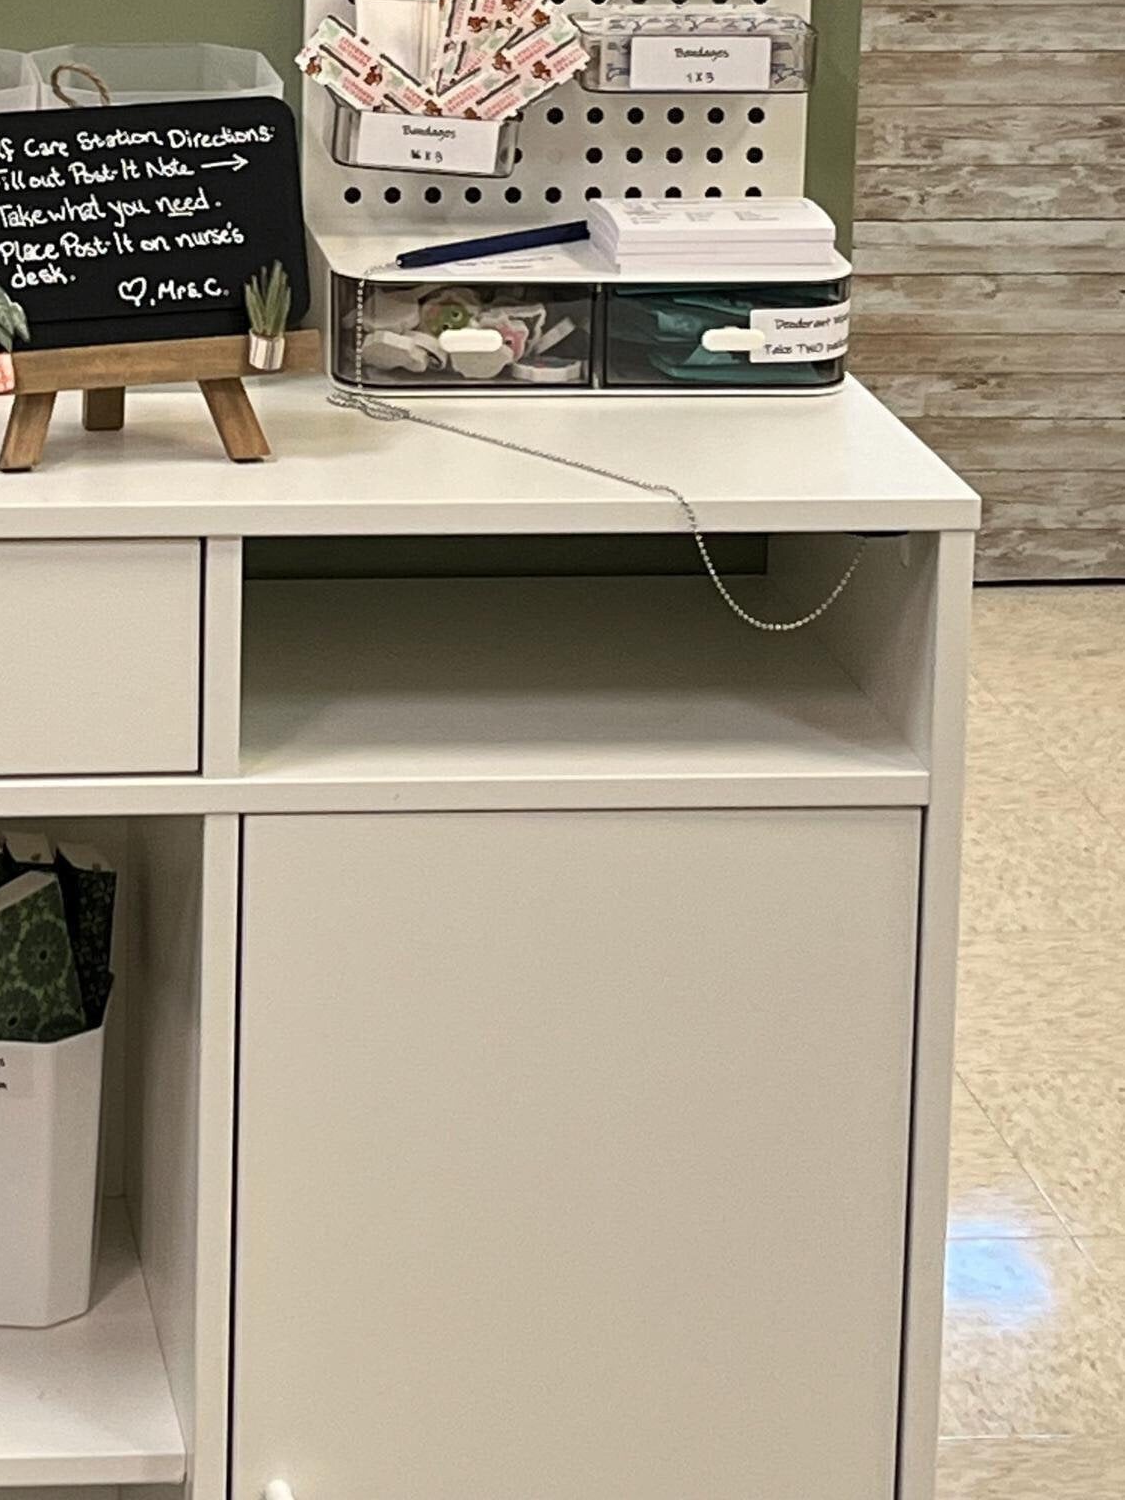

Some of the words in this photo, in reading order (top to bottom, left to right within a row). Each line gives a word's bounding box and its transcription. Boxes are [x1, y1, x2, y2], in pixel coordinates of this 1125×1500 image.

[25, 138, 70, 157] Care
[77, 128, 164, 151] Station
[29, 166, 66, 188] out
[145, 156, 195, 178] Note
[47, 194, 106, 222] what
[107, 199, 151, 227] you
[140, 235, 171, 251] on
[175, 221, 244, 248] nurse's
